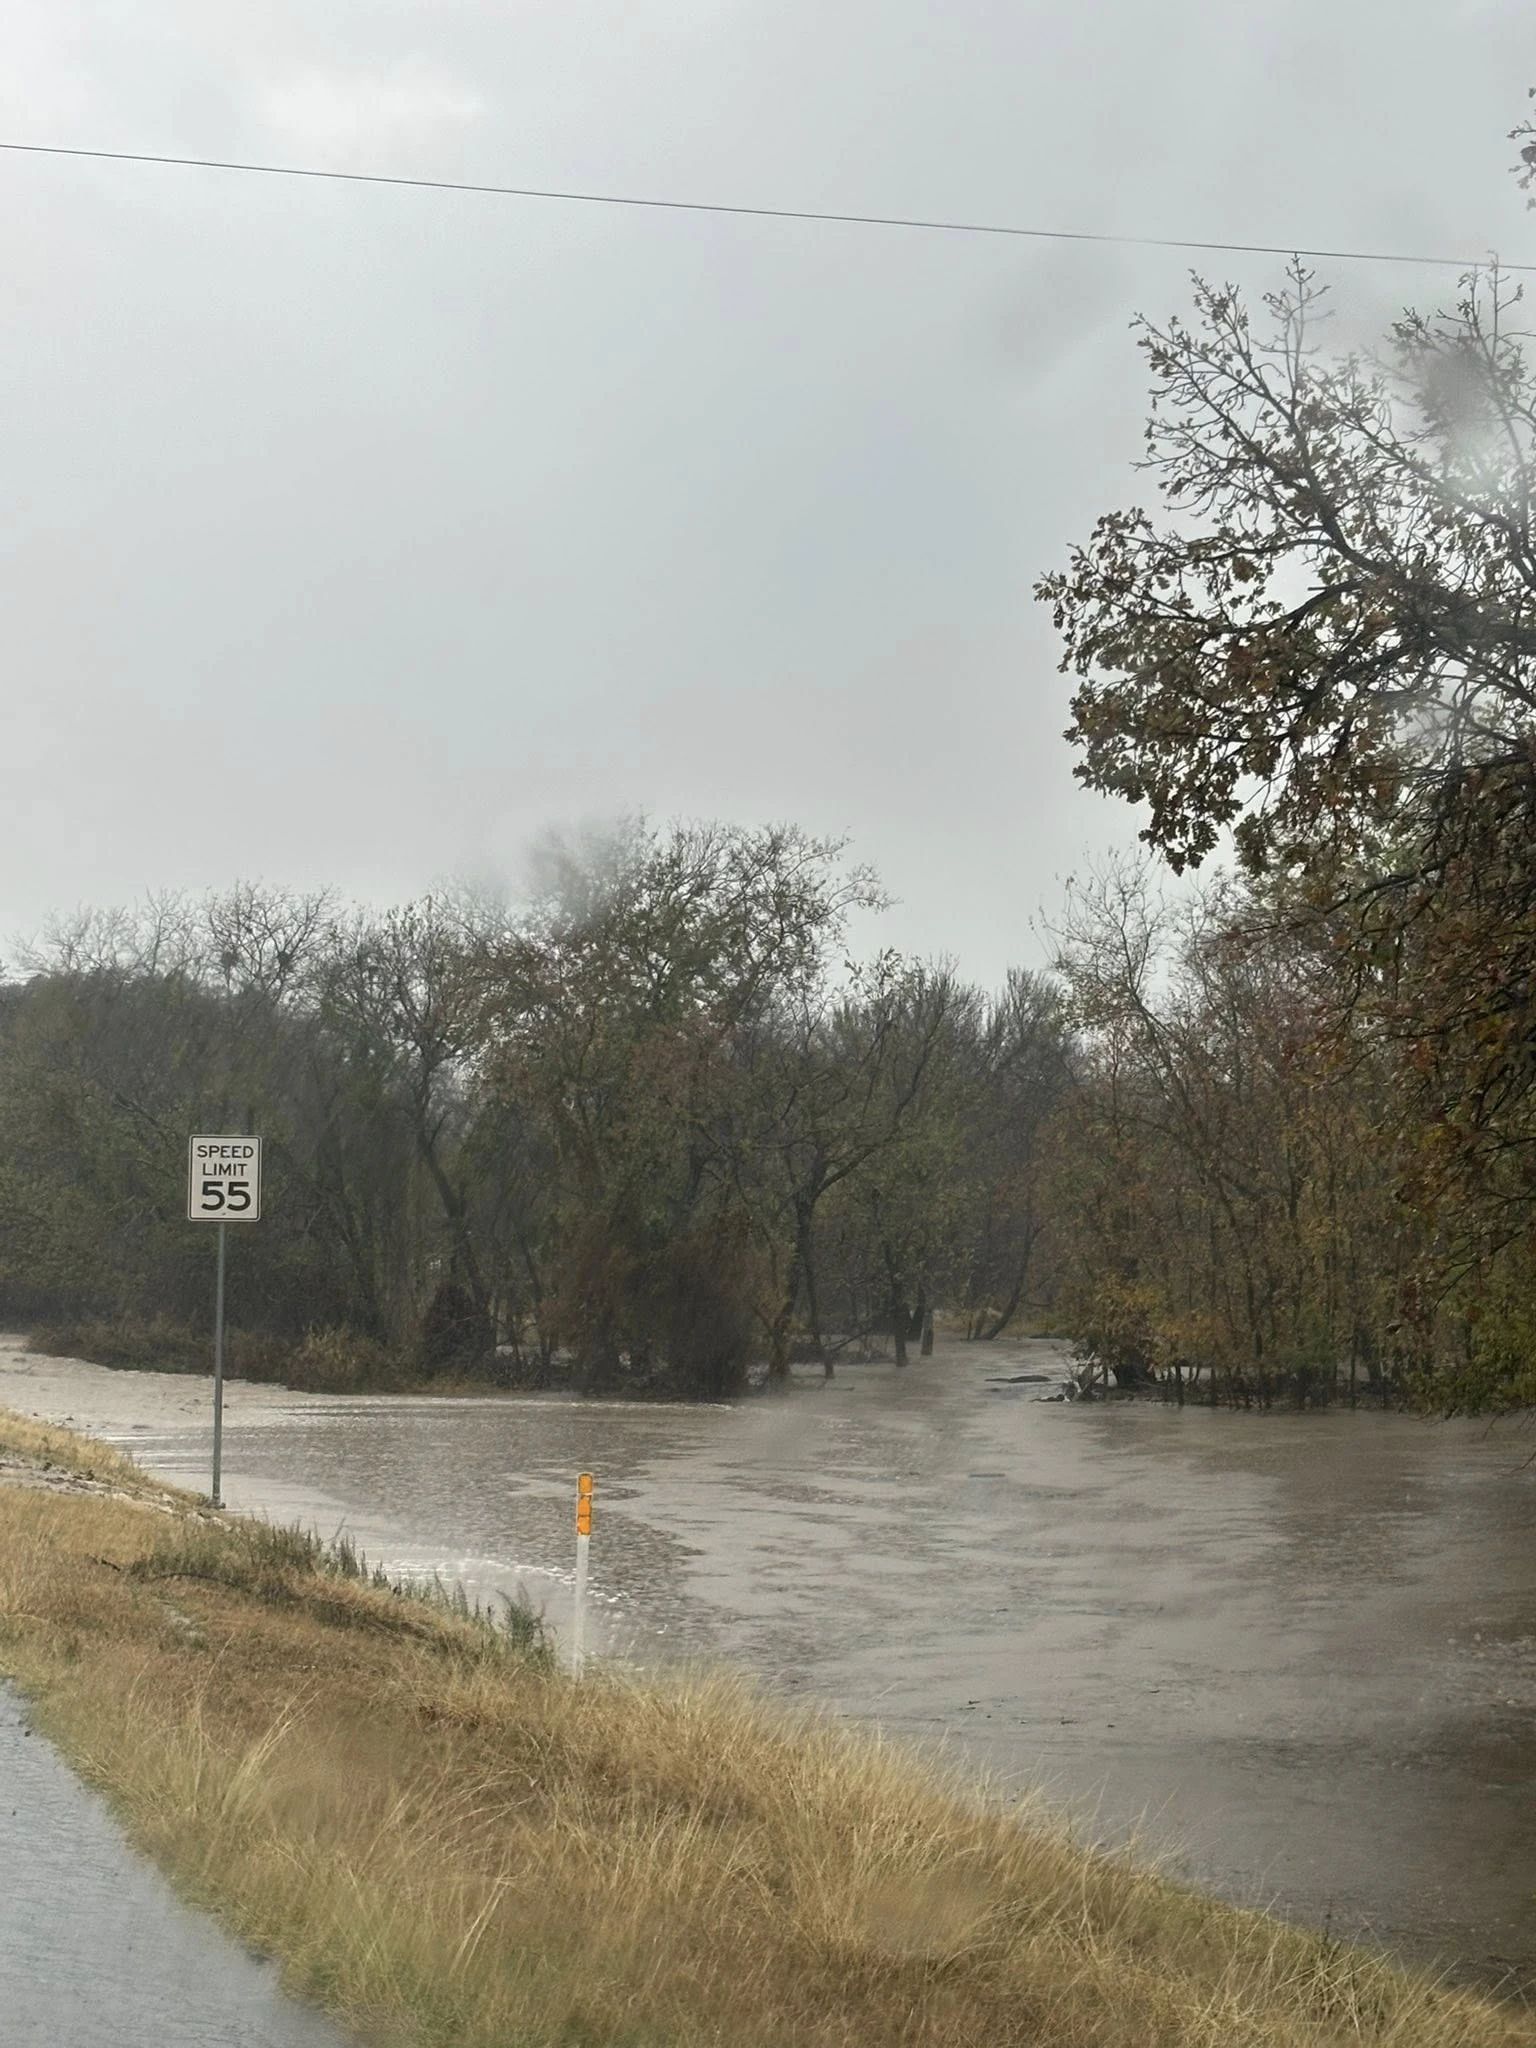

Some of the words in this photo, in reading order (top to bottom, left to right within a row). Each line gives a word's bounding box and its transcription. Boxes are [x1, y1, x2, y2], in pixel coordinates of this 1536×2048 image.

[197, 1145, 254, 1158] SPEED
[202, 1163, 248, 1176] LIMIT
[201, 1181, 251, 1211] 55
